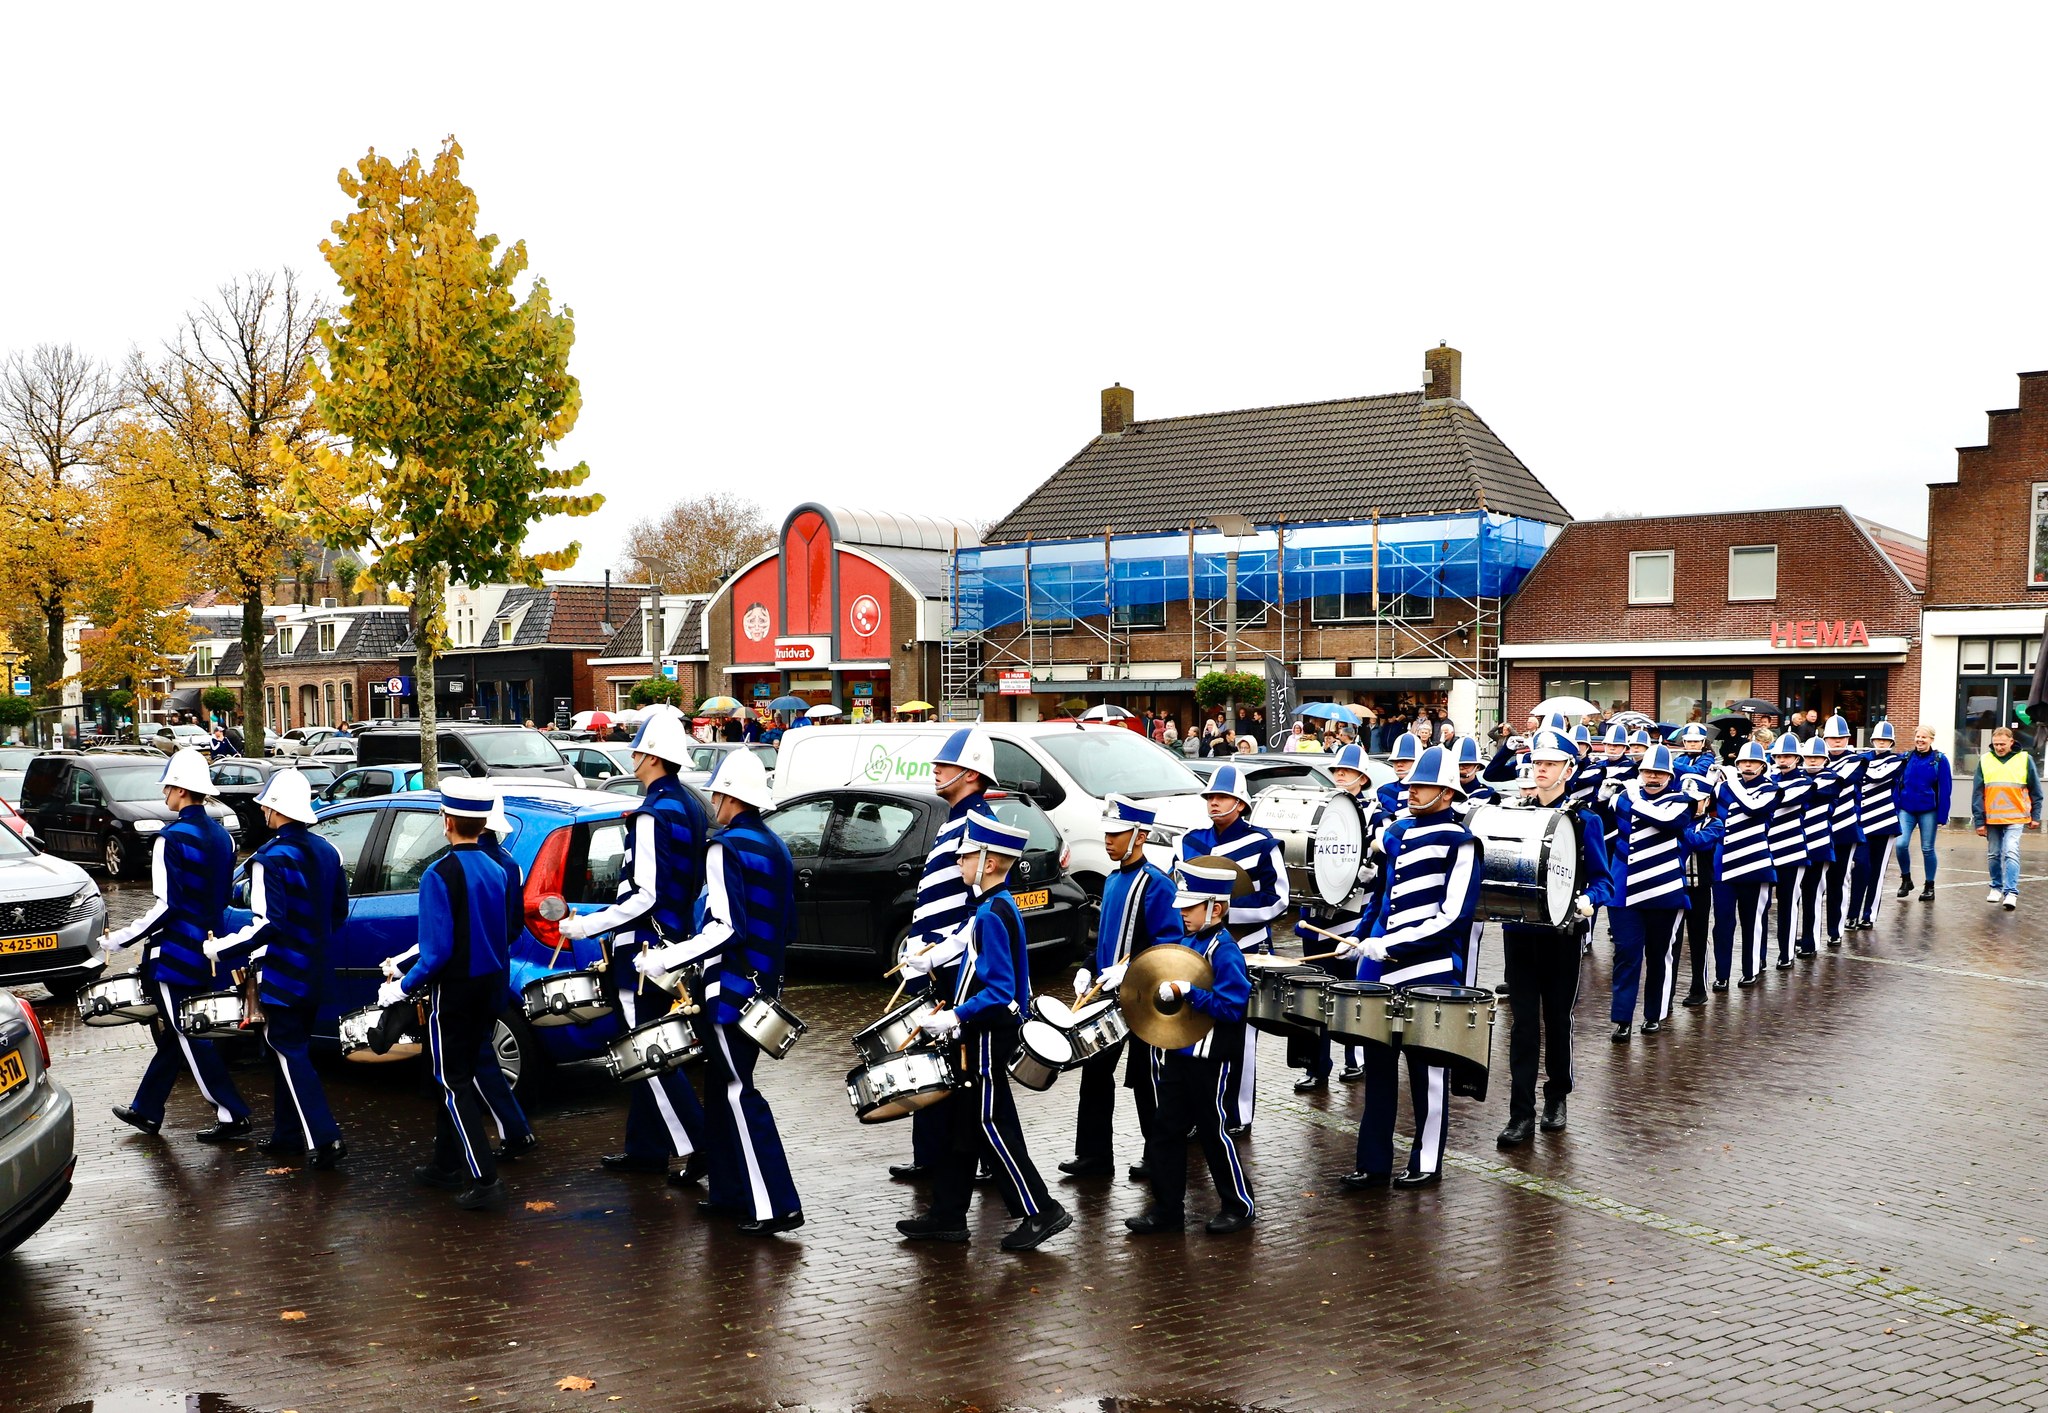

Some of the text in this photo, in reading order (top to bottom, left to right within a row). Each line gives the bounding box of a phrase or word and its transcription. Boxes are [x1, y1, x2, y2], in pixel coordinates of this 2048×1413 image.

[1771, 620, 1869, 647] HEMA
[895, 756, 930, 780] kpn
[1314, 844, 1358, 855] TAKOSTU
[1013, 892, 1047, 907] 0-KGX-5
